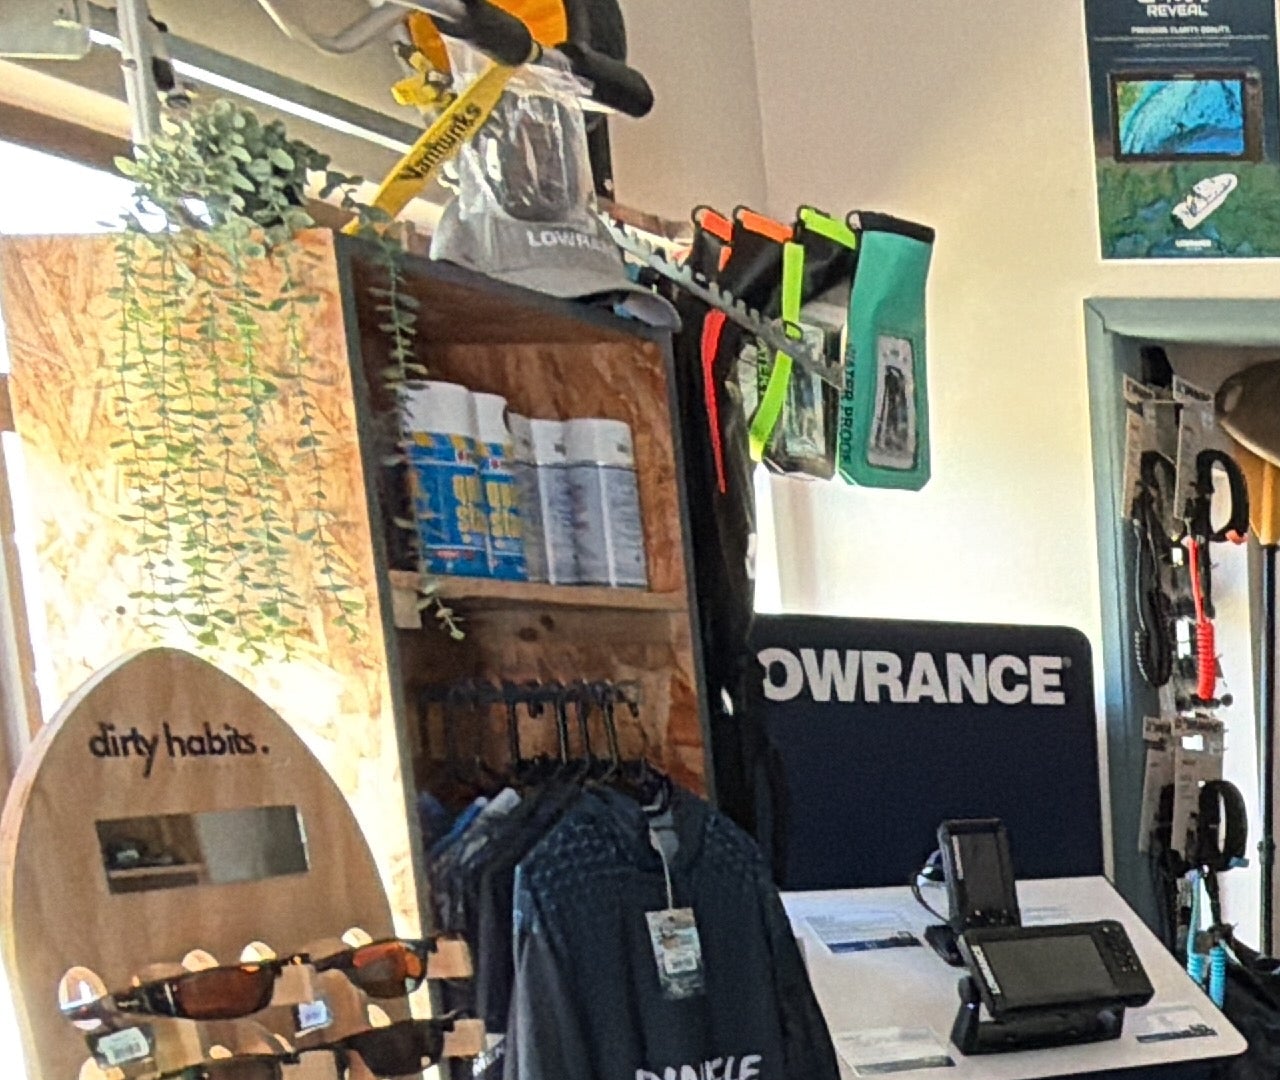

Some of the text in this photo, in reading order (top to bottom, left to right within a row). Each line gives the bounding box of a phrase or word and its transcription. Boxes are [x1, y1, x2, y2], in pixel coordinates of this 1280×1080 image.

[1146, 5, 1209, 17] REVEAL
[398, 102, 482, 181] Vanhunks
[527, 230, 601, 249] LOWRA
[757, 648, 1066, 705] OWRANCE
[89, 721, 159, 779] dirty
